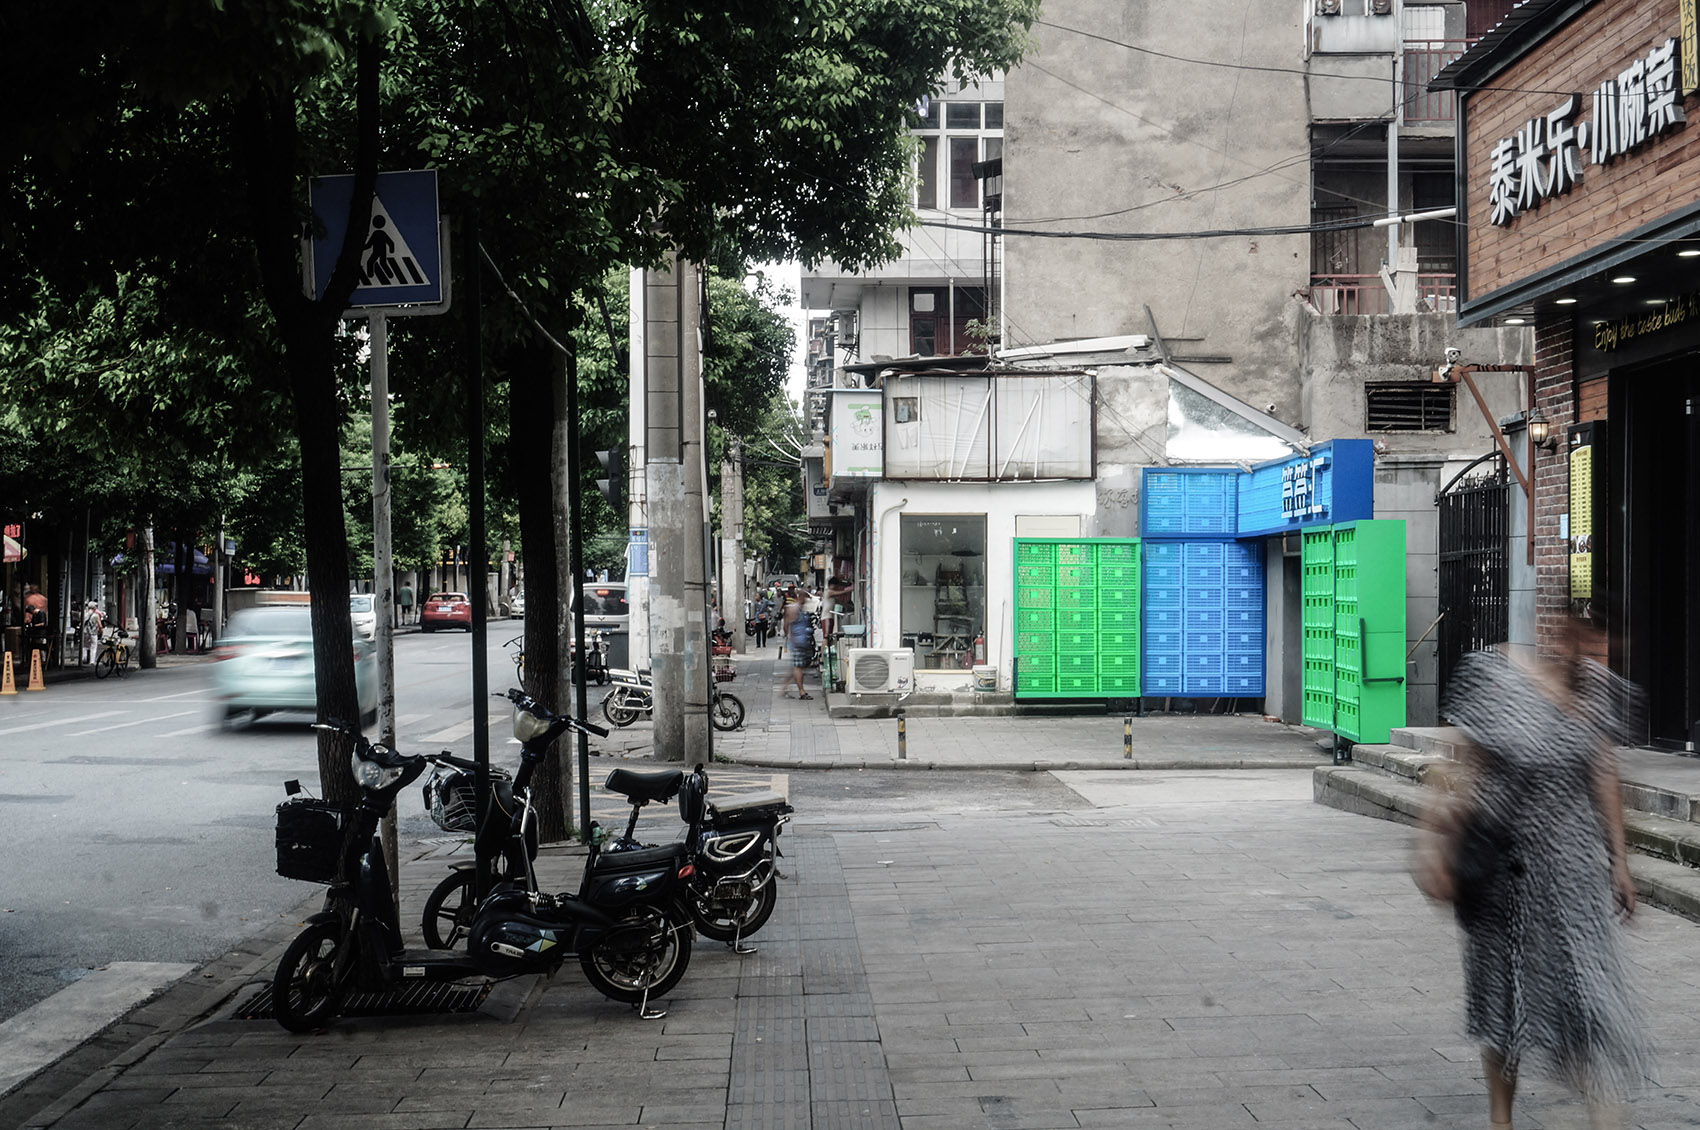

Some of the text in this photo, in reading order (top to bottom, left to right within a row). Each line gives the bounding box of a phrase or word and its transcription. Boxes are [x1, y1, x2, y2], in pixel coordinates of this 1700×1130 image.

[1595, 296, 1686, 352] Enjoy the taste buds
